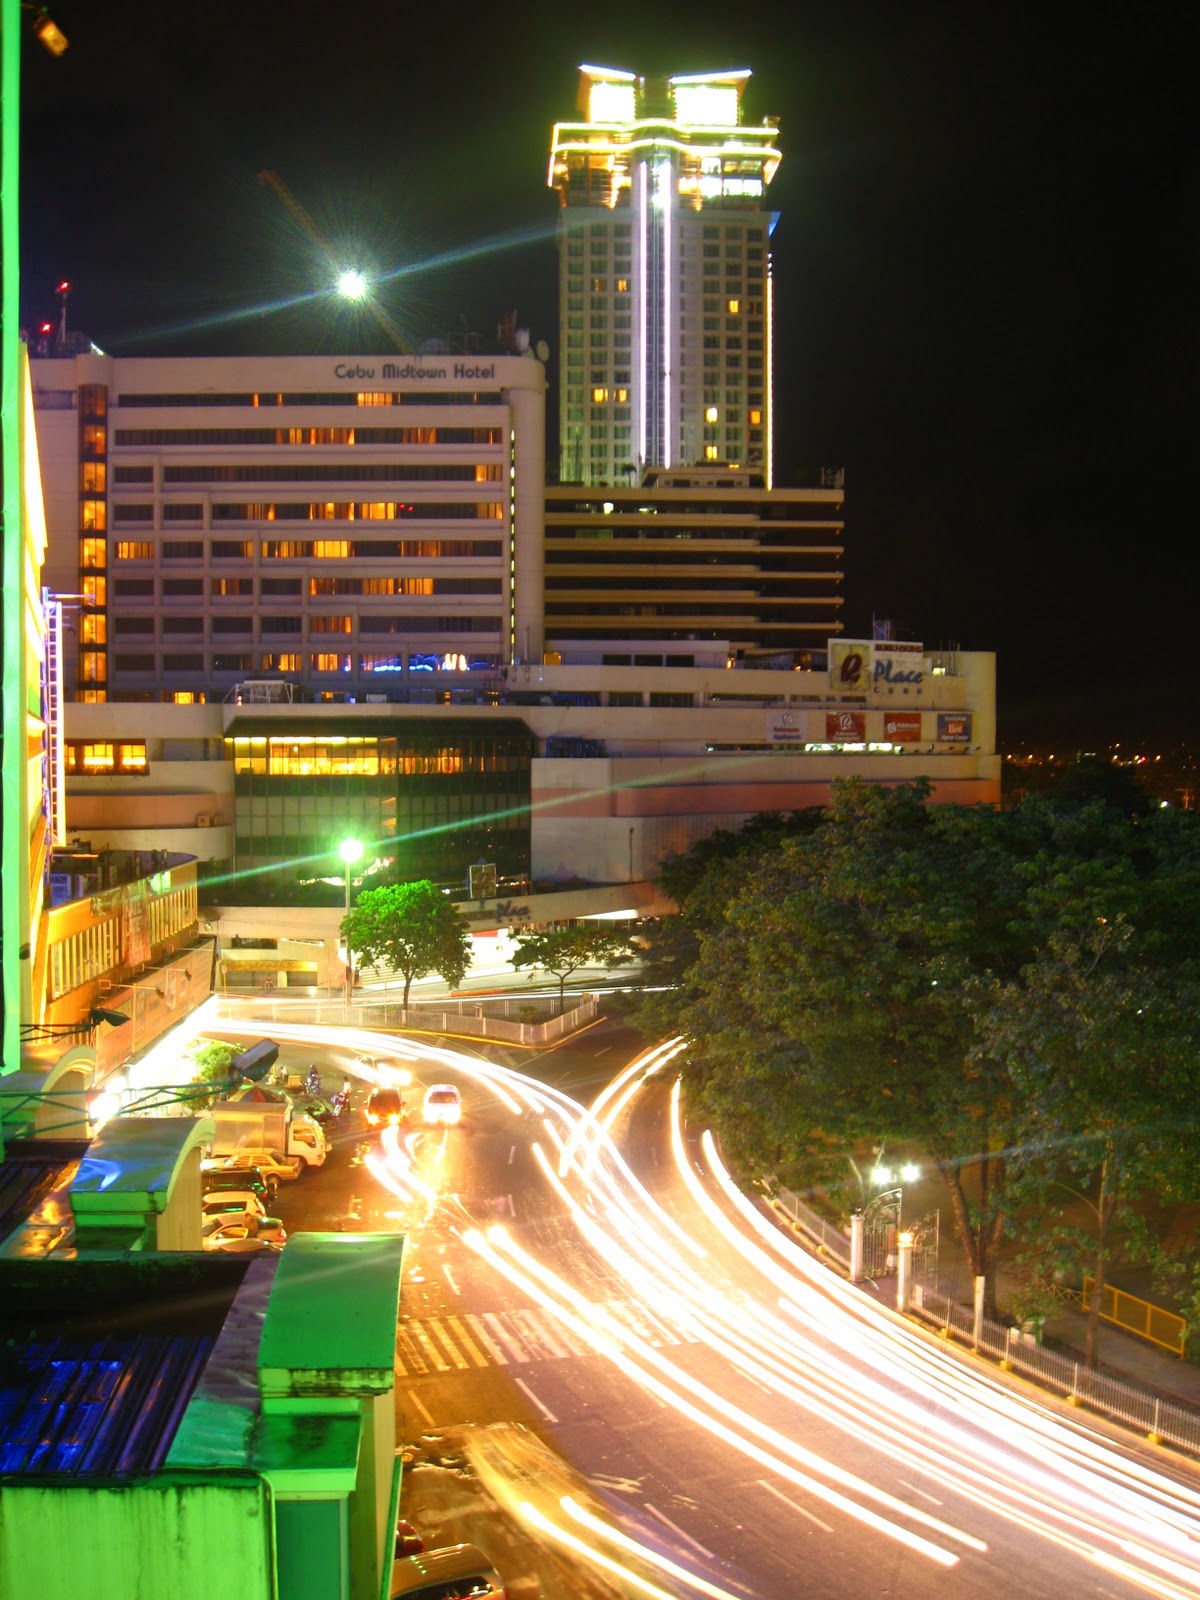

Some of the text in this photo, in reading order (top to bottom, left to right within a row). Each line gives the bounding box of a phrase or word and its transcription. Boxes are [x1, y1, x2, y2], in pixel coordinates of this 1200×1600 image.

[335, 364, 495, 379] Cebu Midtown Hotel
[873, 659, 923, 684] Place
